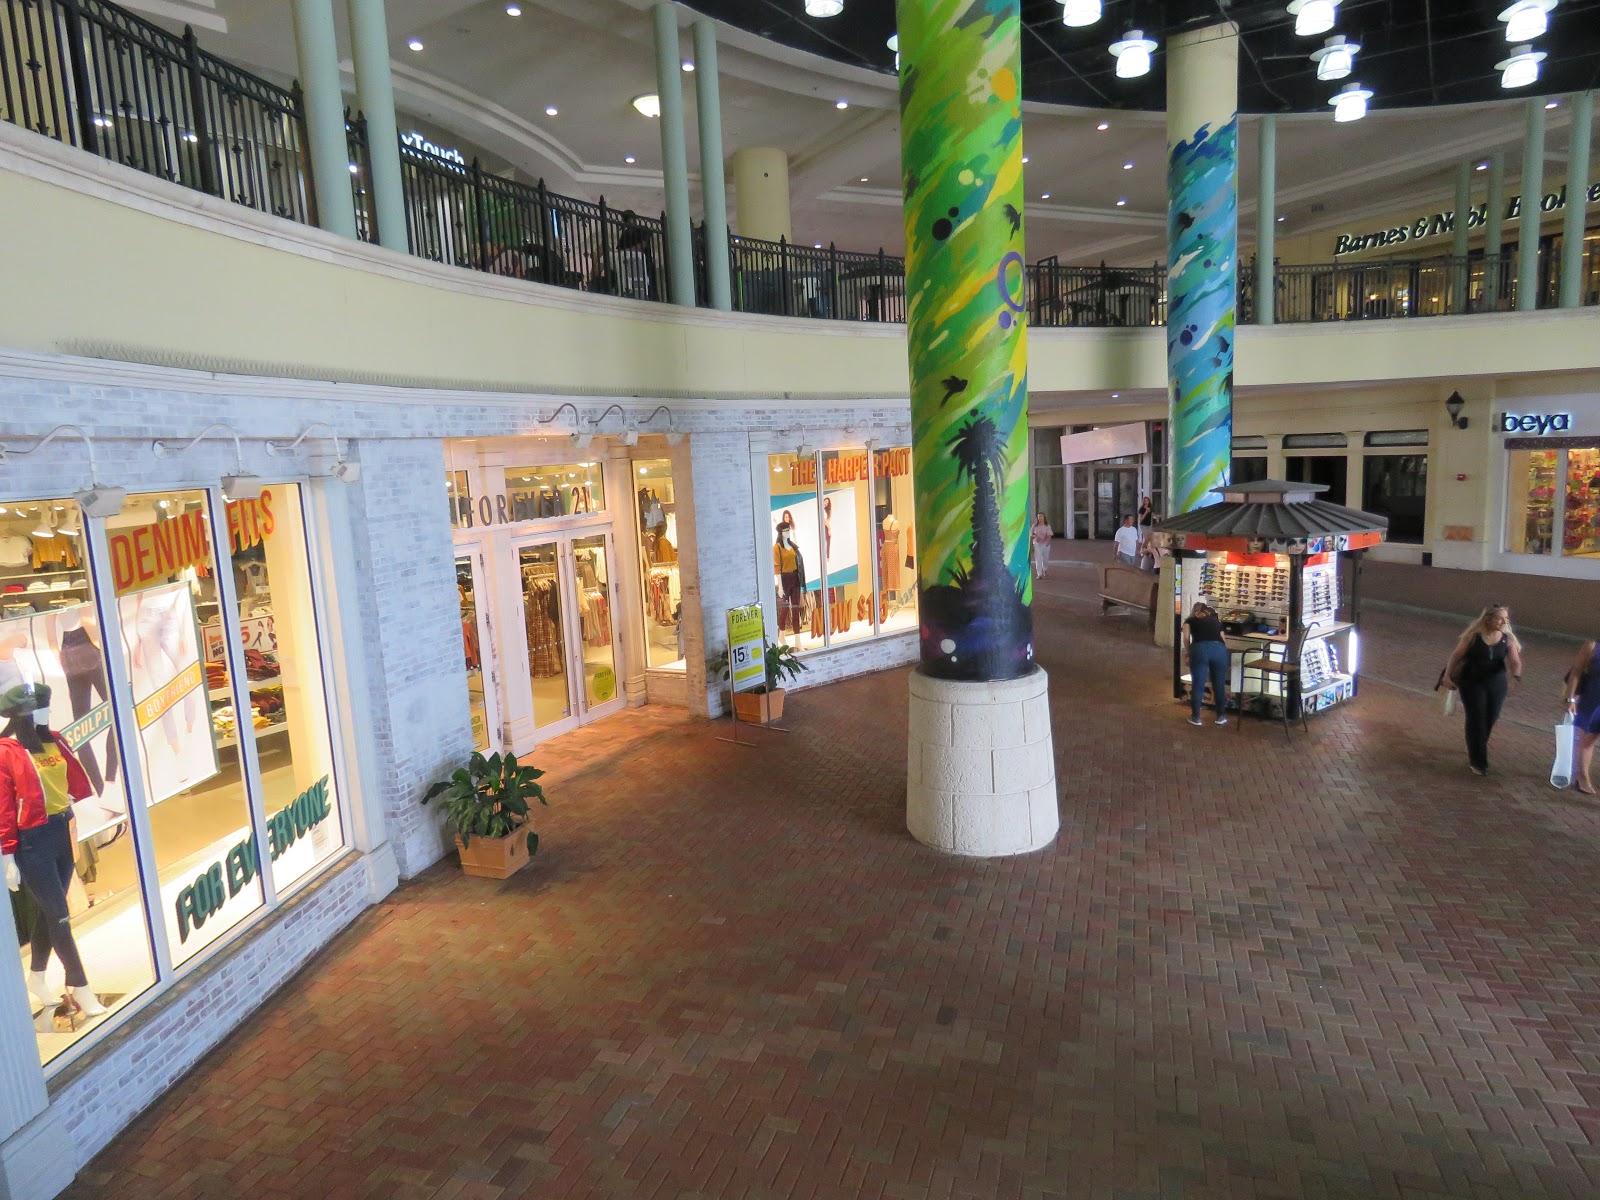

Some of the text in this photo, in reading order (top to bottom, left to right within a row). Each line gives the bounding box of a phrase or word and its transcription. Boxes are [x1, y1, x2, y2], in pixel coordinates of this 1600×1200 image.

[1333, 226, 1409, 256] Barnes
[1412, 217, 1429, 239] &
[1501, 412, 1569, 436] beya
[790, 460, 816, 486] THE
[880, 447, 910, 478] PANT
[466, 486, 589, 529] FOREVER 21
[109, 489, 275, 592] DENIM FITS
[145, 671, 195, 719] BOYFRIEND
[65, 705, 110, 749] SCULPT
[175, 774, 332, 946] FOR EVERYONE
